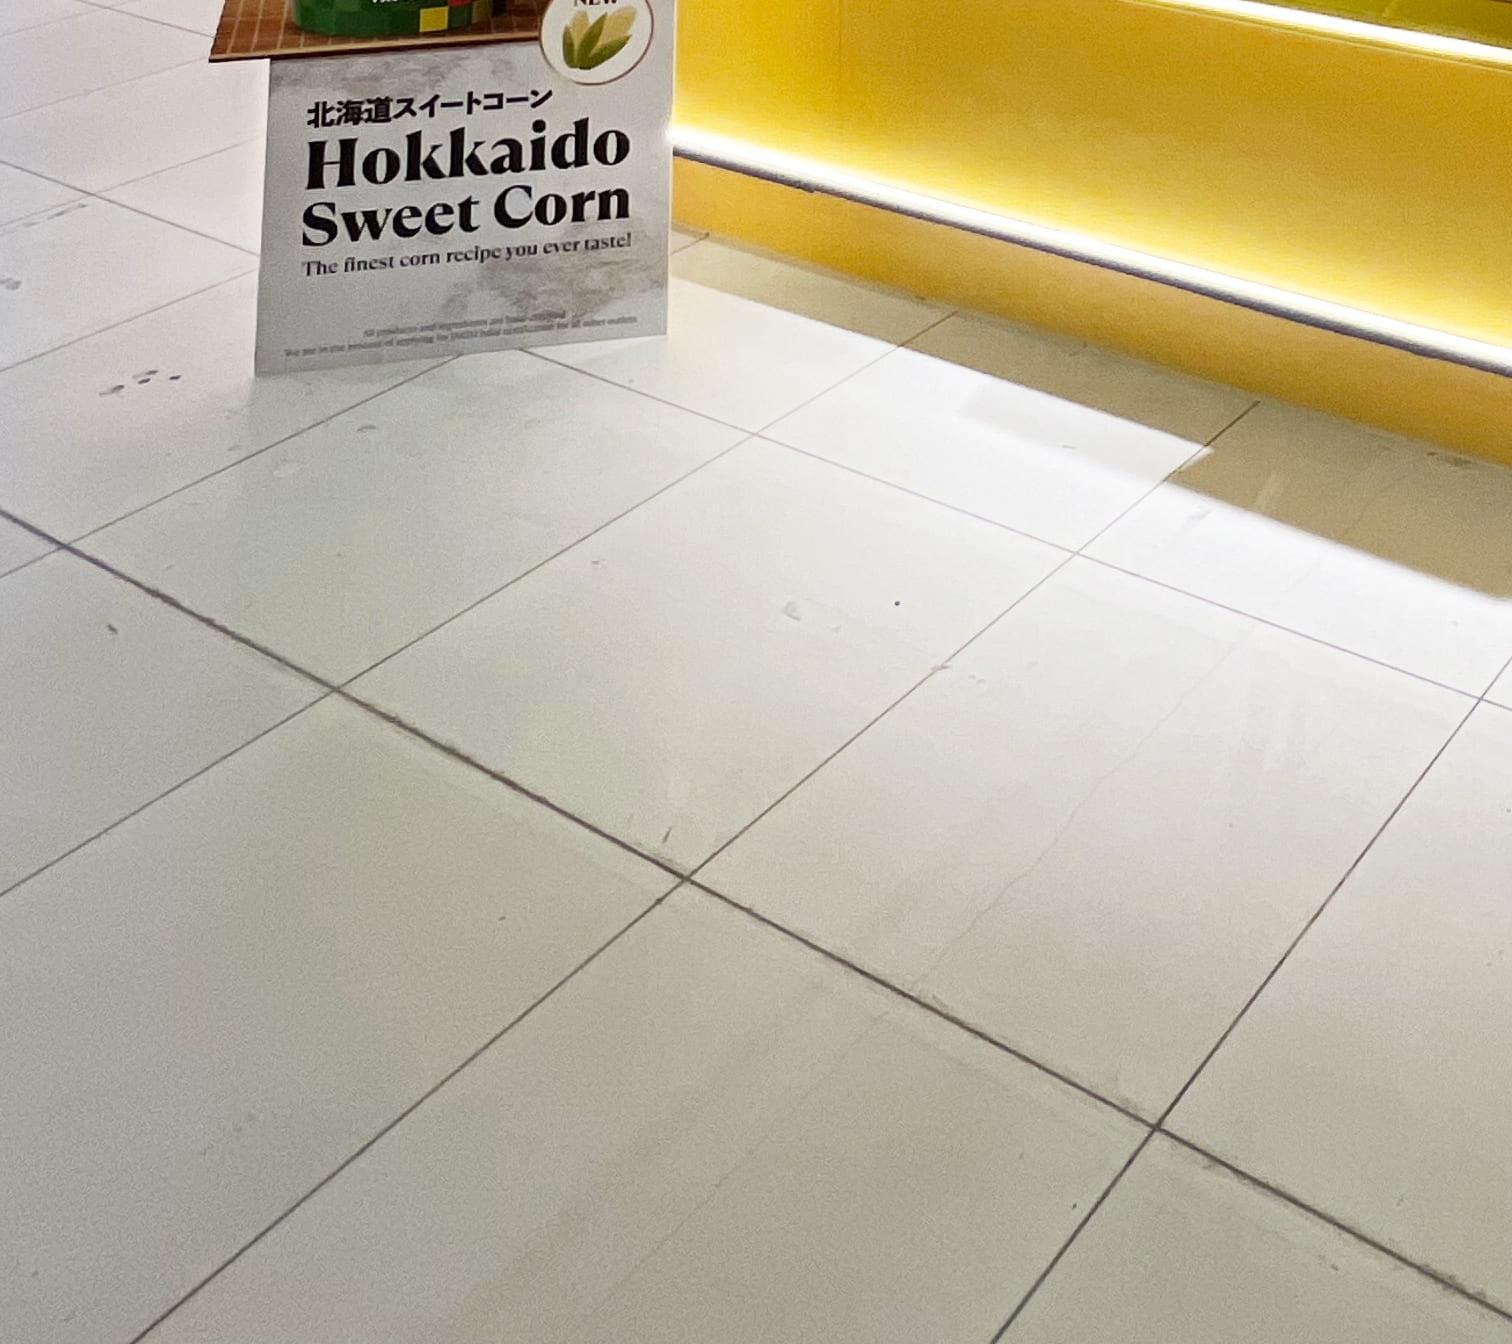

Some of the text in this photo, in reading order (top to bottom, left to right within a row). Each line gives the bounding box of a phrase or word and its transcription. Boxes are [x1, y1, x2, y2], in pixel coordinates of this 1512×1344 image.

[307, 89, 554, 129] 北海道スイートコーン
[305, 117, 630, 191] Hokkaido
[301, 184, 630, 248] Sweet Corn
[302, 232, 632, 277] The finest corn recipe you ever taste!
